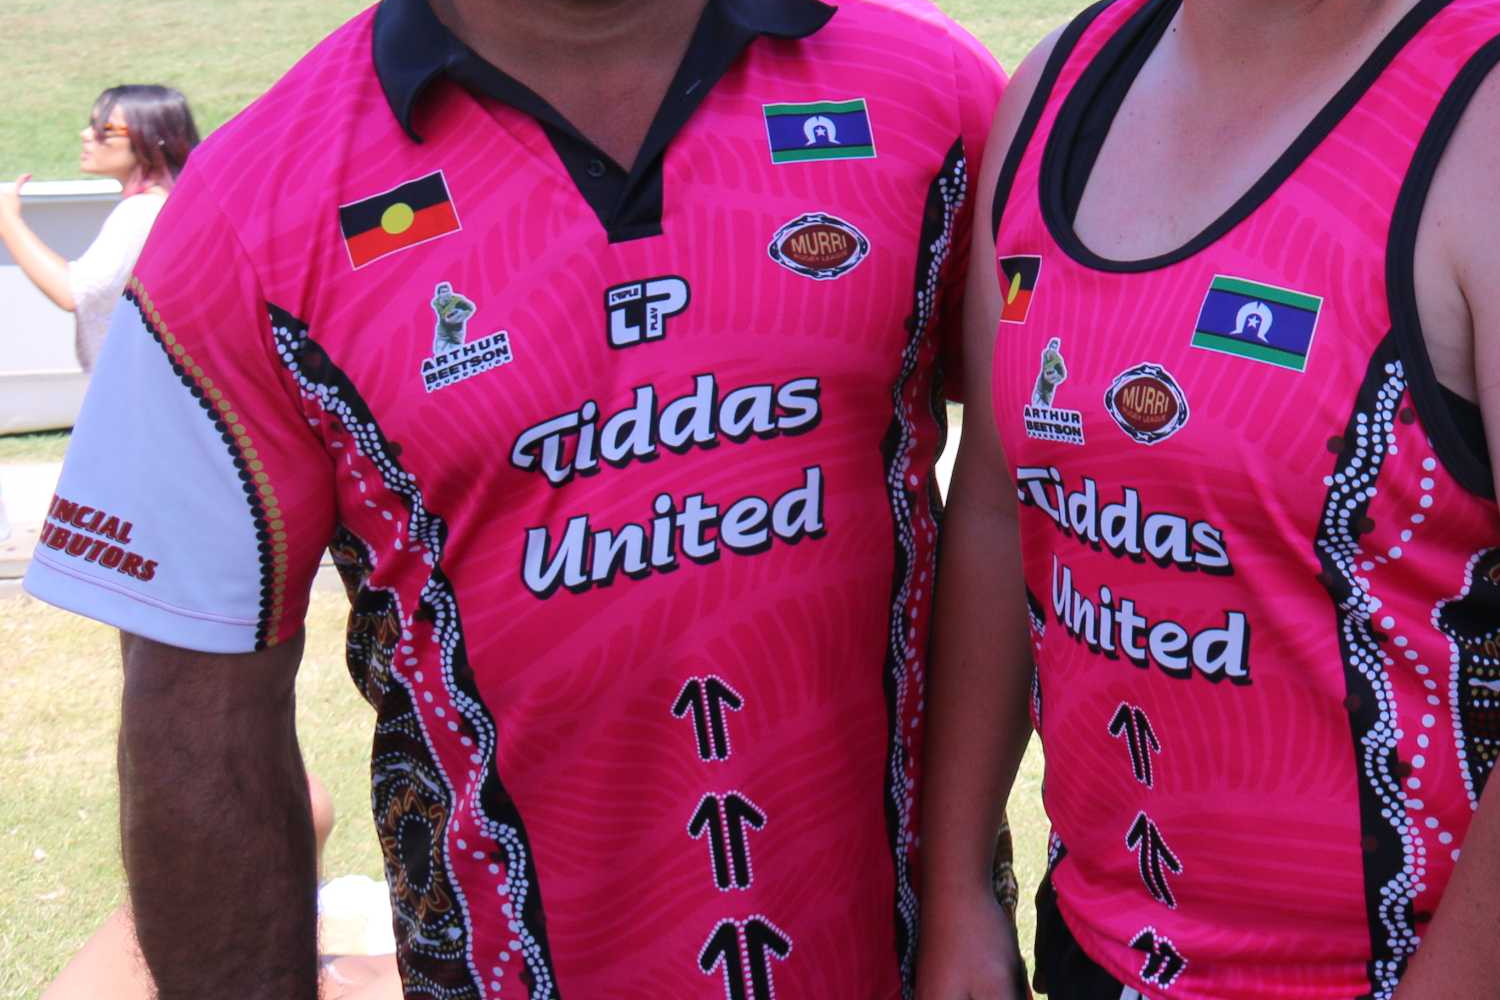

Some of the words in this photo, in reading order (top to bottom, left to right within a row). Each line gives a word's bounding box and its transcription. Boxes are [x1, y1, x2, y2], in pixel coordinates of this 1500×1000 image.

[791, 231, 848, 255] MURRI
[423, 333, 506, 373] ARTHUR
[425, 345, 509, 385] BEETSON
[1024, 407, 1080, 424] ARTHUR
[1122, 386, 1170, 414] MURRI
[510, 372, 822, 488] Tiddas
[1026, 420, 1081, 438] BEETSON
[522, 465, 826, 600] United
[1016, 465, 1235, 576] Tiddas
[41, 520, 159, 582] IBUTORS
[1051, 552, 1253, 685] United
